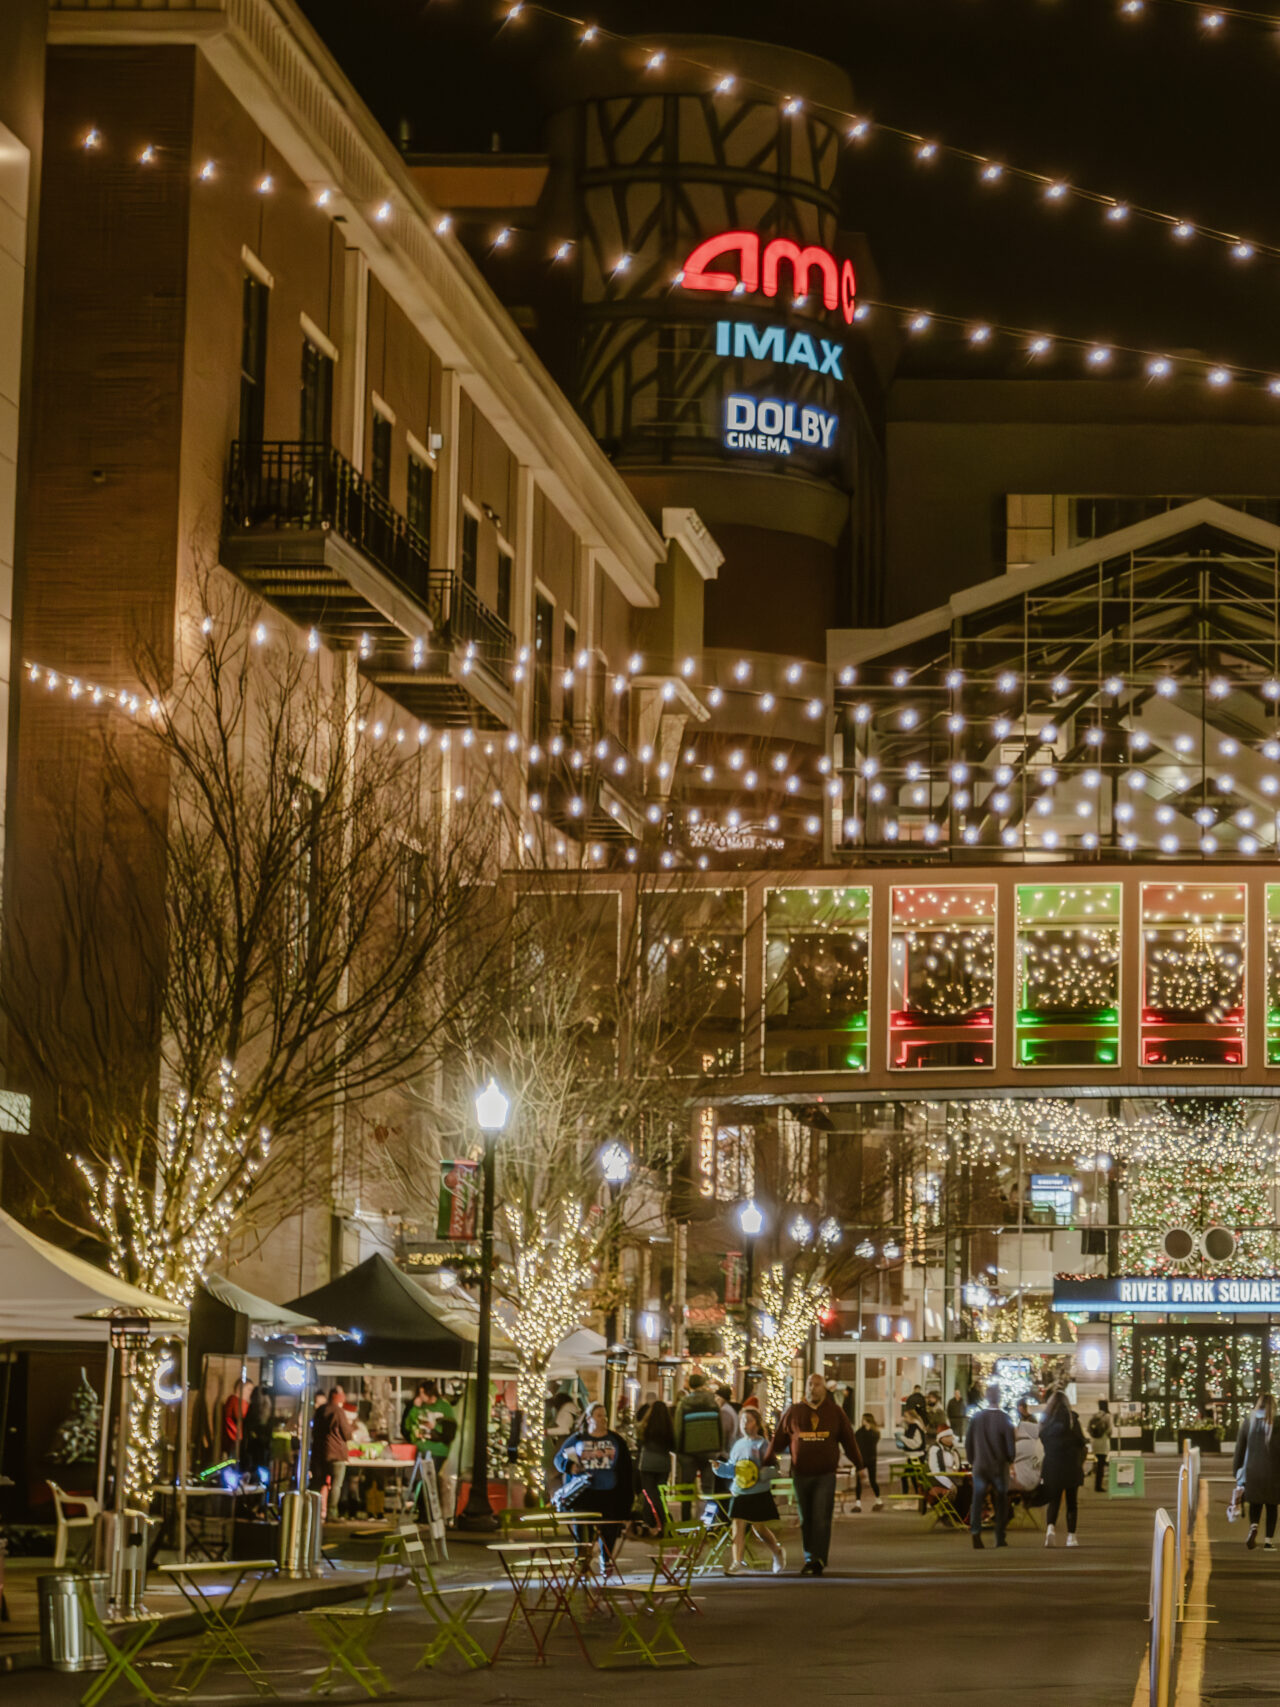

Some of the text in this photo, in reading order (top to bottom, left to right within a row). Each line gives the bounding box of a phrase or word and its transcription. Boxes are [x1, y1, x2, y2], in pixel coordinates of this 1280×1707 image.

[716, 320, 844, 381] IMAX
[727, 396, 835, 448] DOLBY
[727, 431, 791, 454] CINEMA
[1120, 1281, 1280, 1303] RIVER PARK SQUARE
